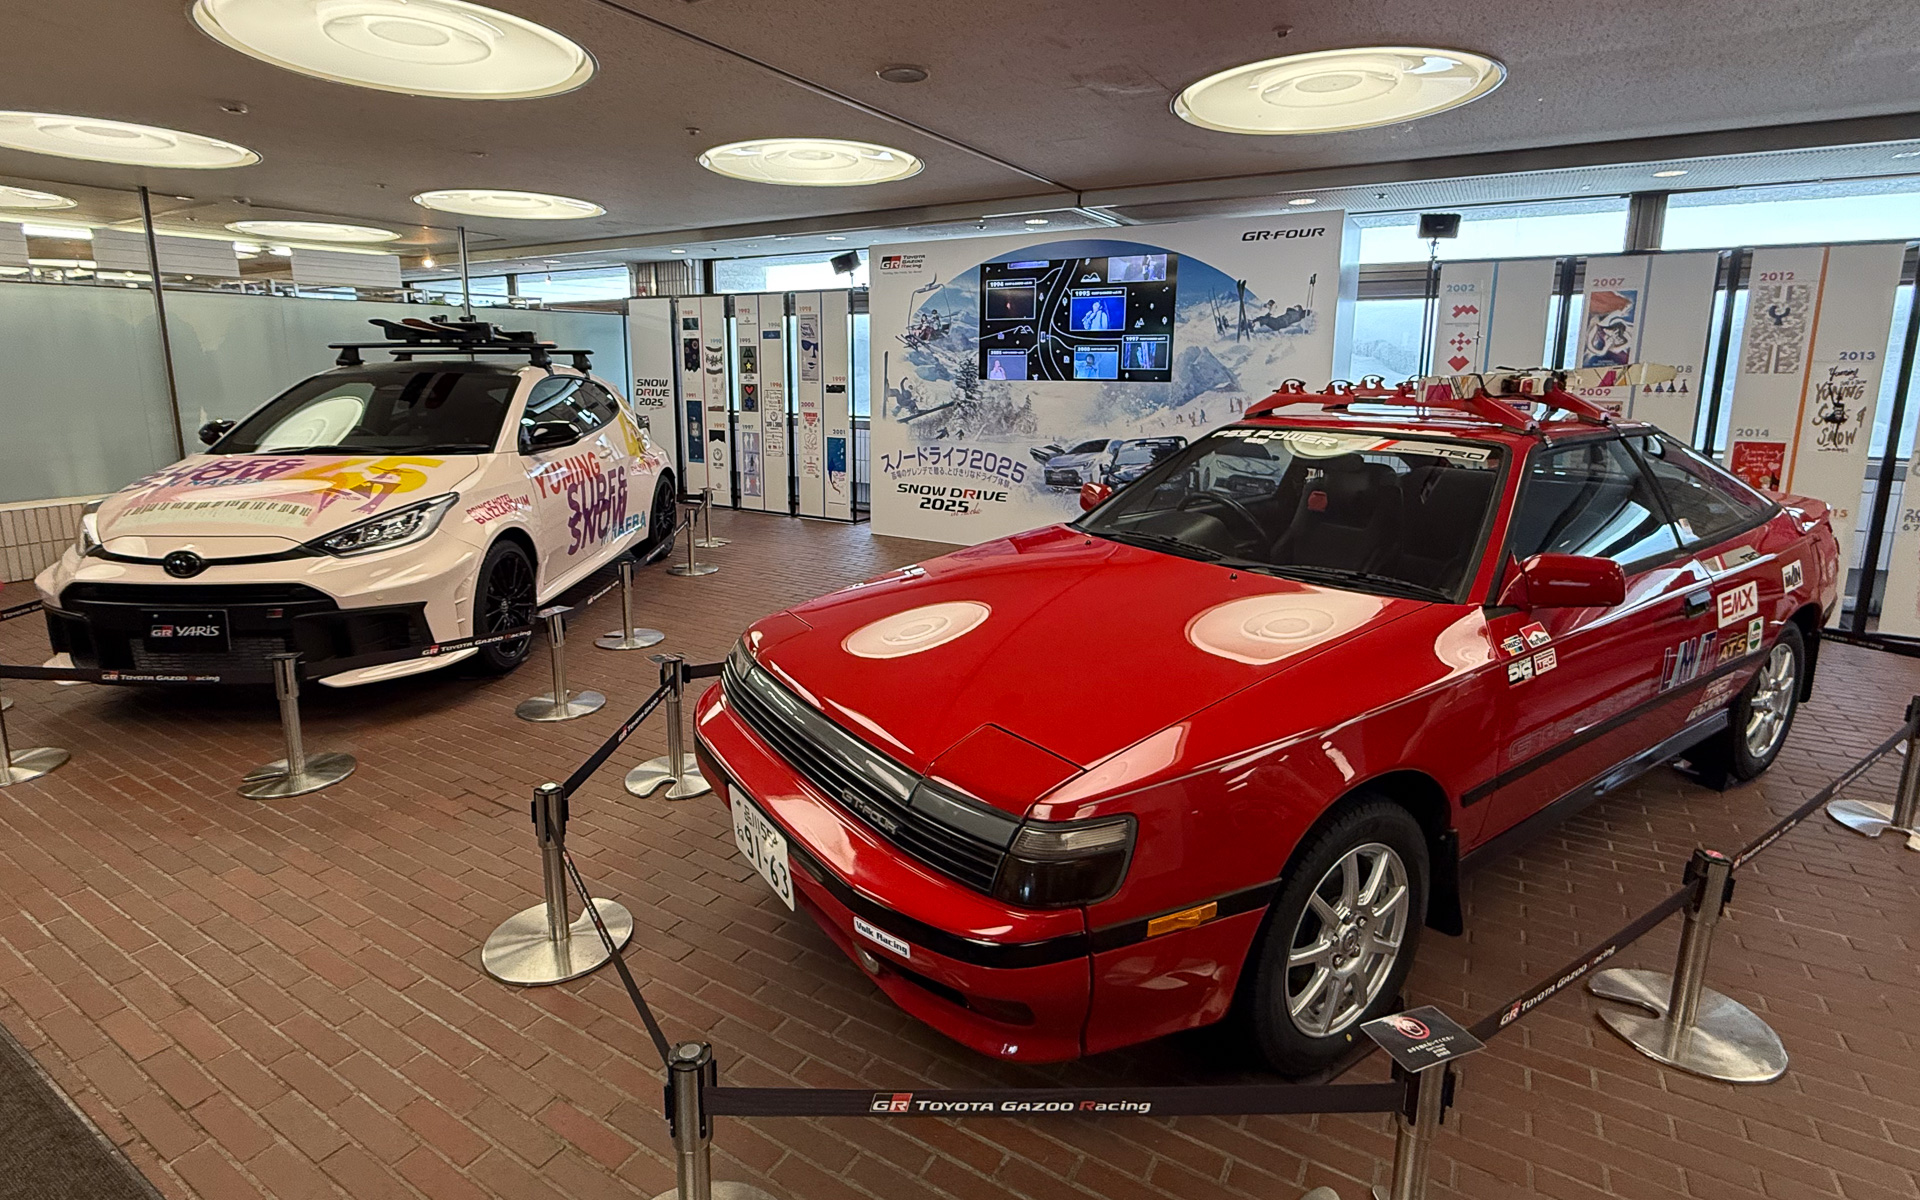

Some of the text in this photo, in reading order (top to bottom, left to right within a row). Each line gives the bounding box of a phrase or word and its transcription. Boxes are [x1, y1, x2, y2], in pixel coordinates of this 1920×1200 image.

[1593, 278, 1625, 287] 2007
[1760, 272, 1795, 282] 2012
[1446, 284, 1475, 292] 2002
[1839, 351, 1876, 360] 2013
[636, 379, 668, 387] SNOW
[636, 388, 670, 397] DRIVE
[1579, 388, 1611, 396] 2009
[639, 398, 663, 406] 2025
[1736, 428, 1769, 437] 2014
[1253, 430, 1338, 447] POWER
[1435, 448, 1485, 460] TRD
[881, 446, 1027, 484] スノードライブ2025
[535, 452, 600, 499] YUMING
[897, 483, 1008, 503] SNOW DRIVE
[920, 497, 969, 513] 2025
[1832, 508, 1848, 518] 15
[151, 627, 173, 637] GR
[422, 646, 439, 656] GR
[440, 641, 473, 652] TOYOTA
[474, 635, 503, 647] GAZOO
[101, 672, 119, 681] GR
[189, 674, 220, 682] Racing
[842, 788, 899, 835] GT-FOUR
[745, 824, 789, 899] 91-63
[856, 920, 908, 956] Volk Racing
[1500, 946, 1616, 1025] GR TOYOTA GAZOO Racing
[870, 1097, 1151, 1114] GR TOYOTA GAZOO Racing
